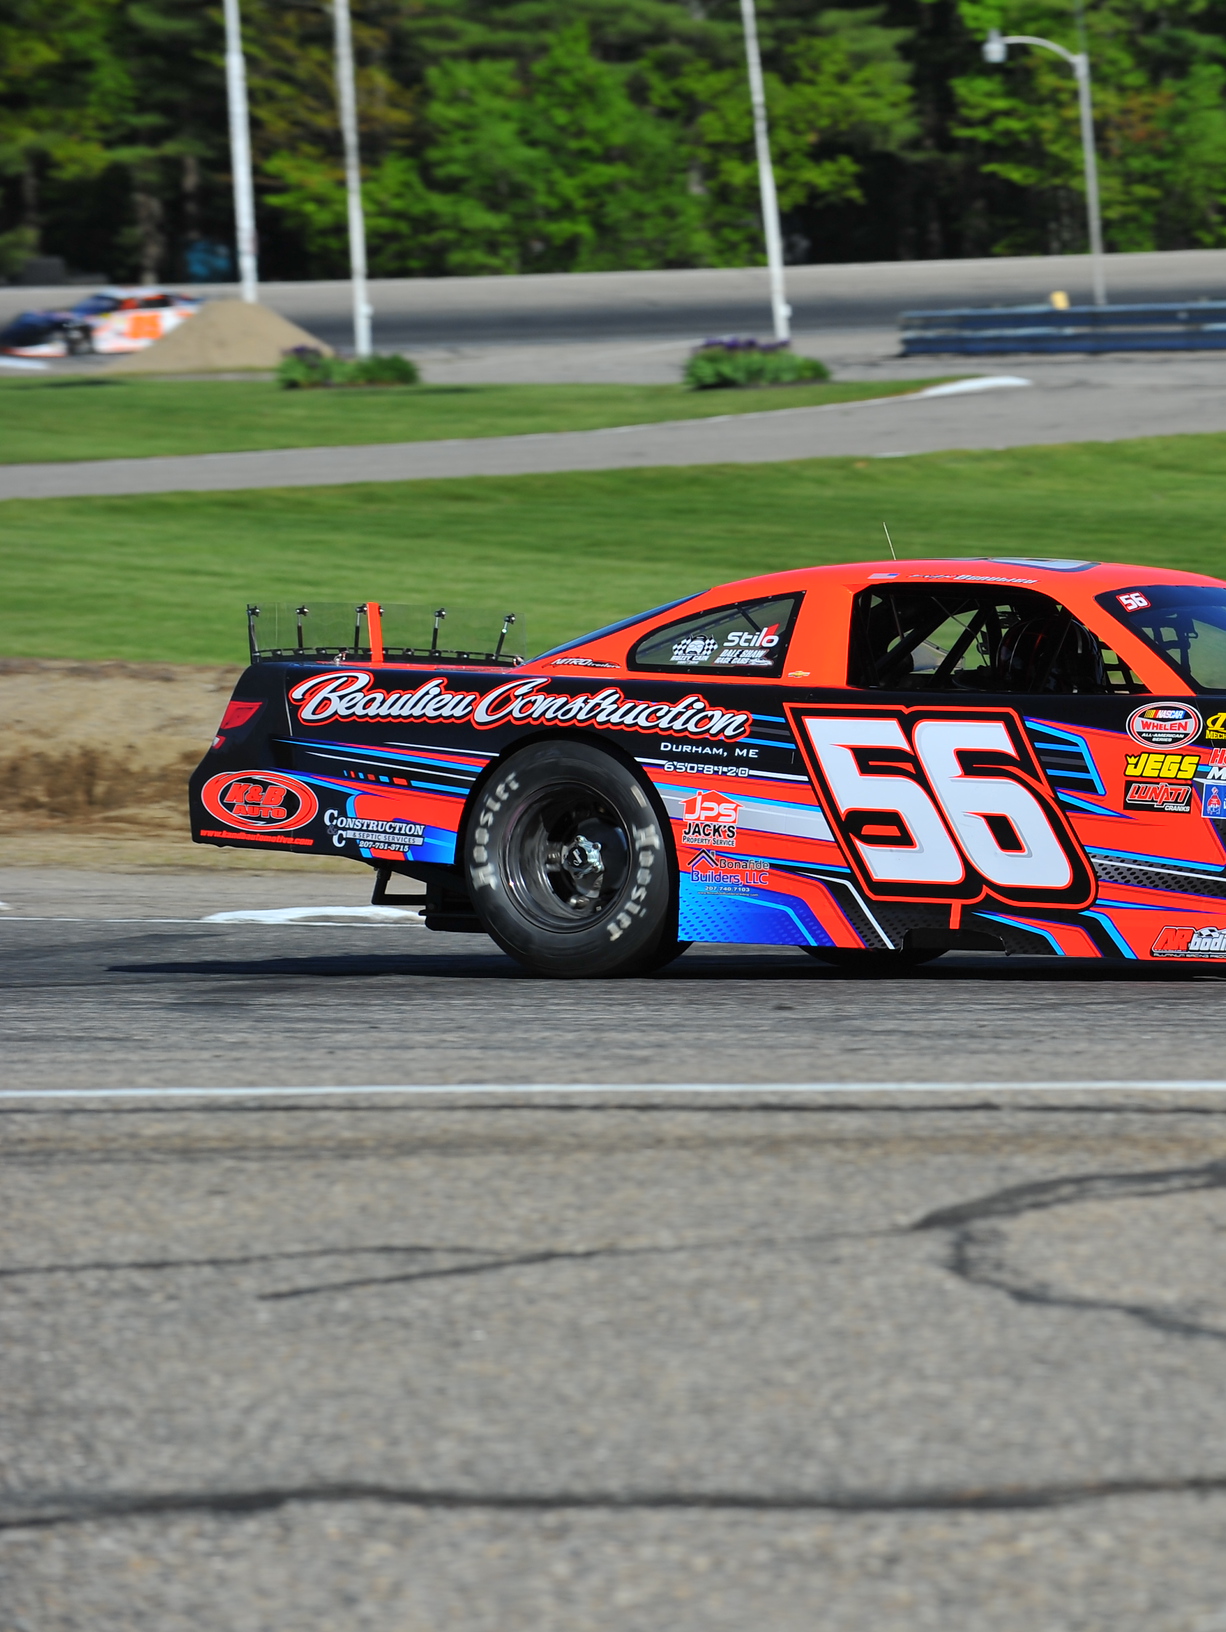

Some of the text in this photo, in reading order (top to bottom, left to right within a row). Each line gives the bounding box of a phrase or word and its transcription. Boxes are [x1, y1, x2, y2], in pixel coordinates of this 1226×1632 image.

[1118, 594, 1149, 610] 56
[723, 626, 780, 648] Stilo
[290, 671, 751, 738] Beaulieu Construction
[1156, 709, 1184, 719] NASCAR
[1140, 719, 1189, 731] WHELEN
[660, 742, 759, 758] DURHAM, ME
[1125, 753, 1200, 779] JEGS
[224, 783, 287, 806] K&B
[1129, 785, 1189, 804] LUNATI
[685, 795, 737, 822] JPS
[801, 716, 1073, 890] 56
[232, 804, 287, 819] AUTO
[324, 809, 425, 835] CONSTRUCTION
[358, 832, 381, 841] SEPTIC
[383, 834, 416, 844] SERVICES
[683, 823, 736, 839] JACK'S
[358, 840, 409, 852] 207-751-3715
[682, 835, 736, 847] PROPERTY SERVICE
[719, 858, 770, 870] Bonafide
[691, 870, 769, 886] Builders, LLC
